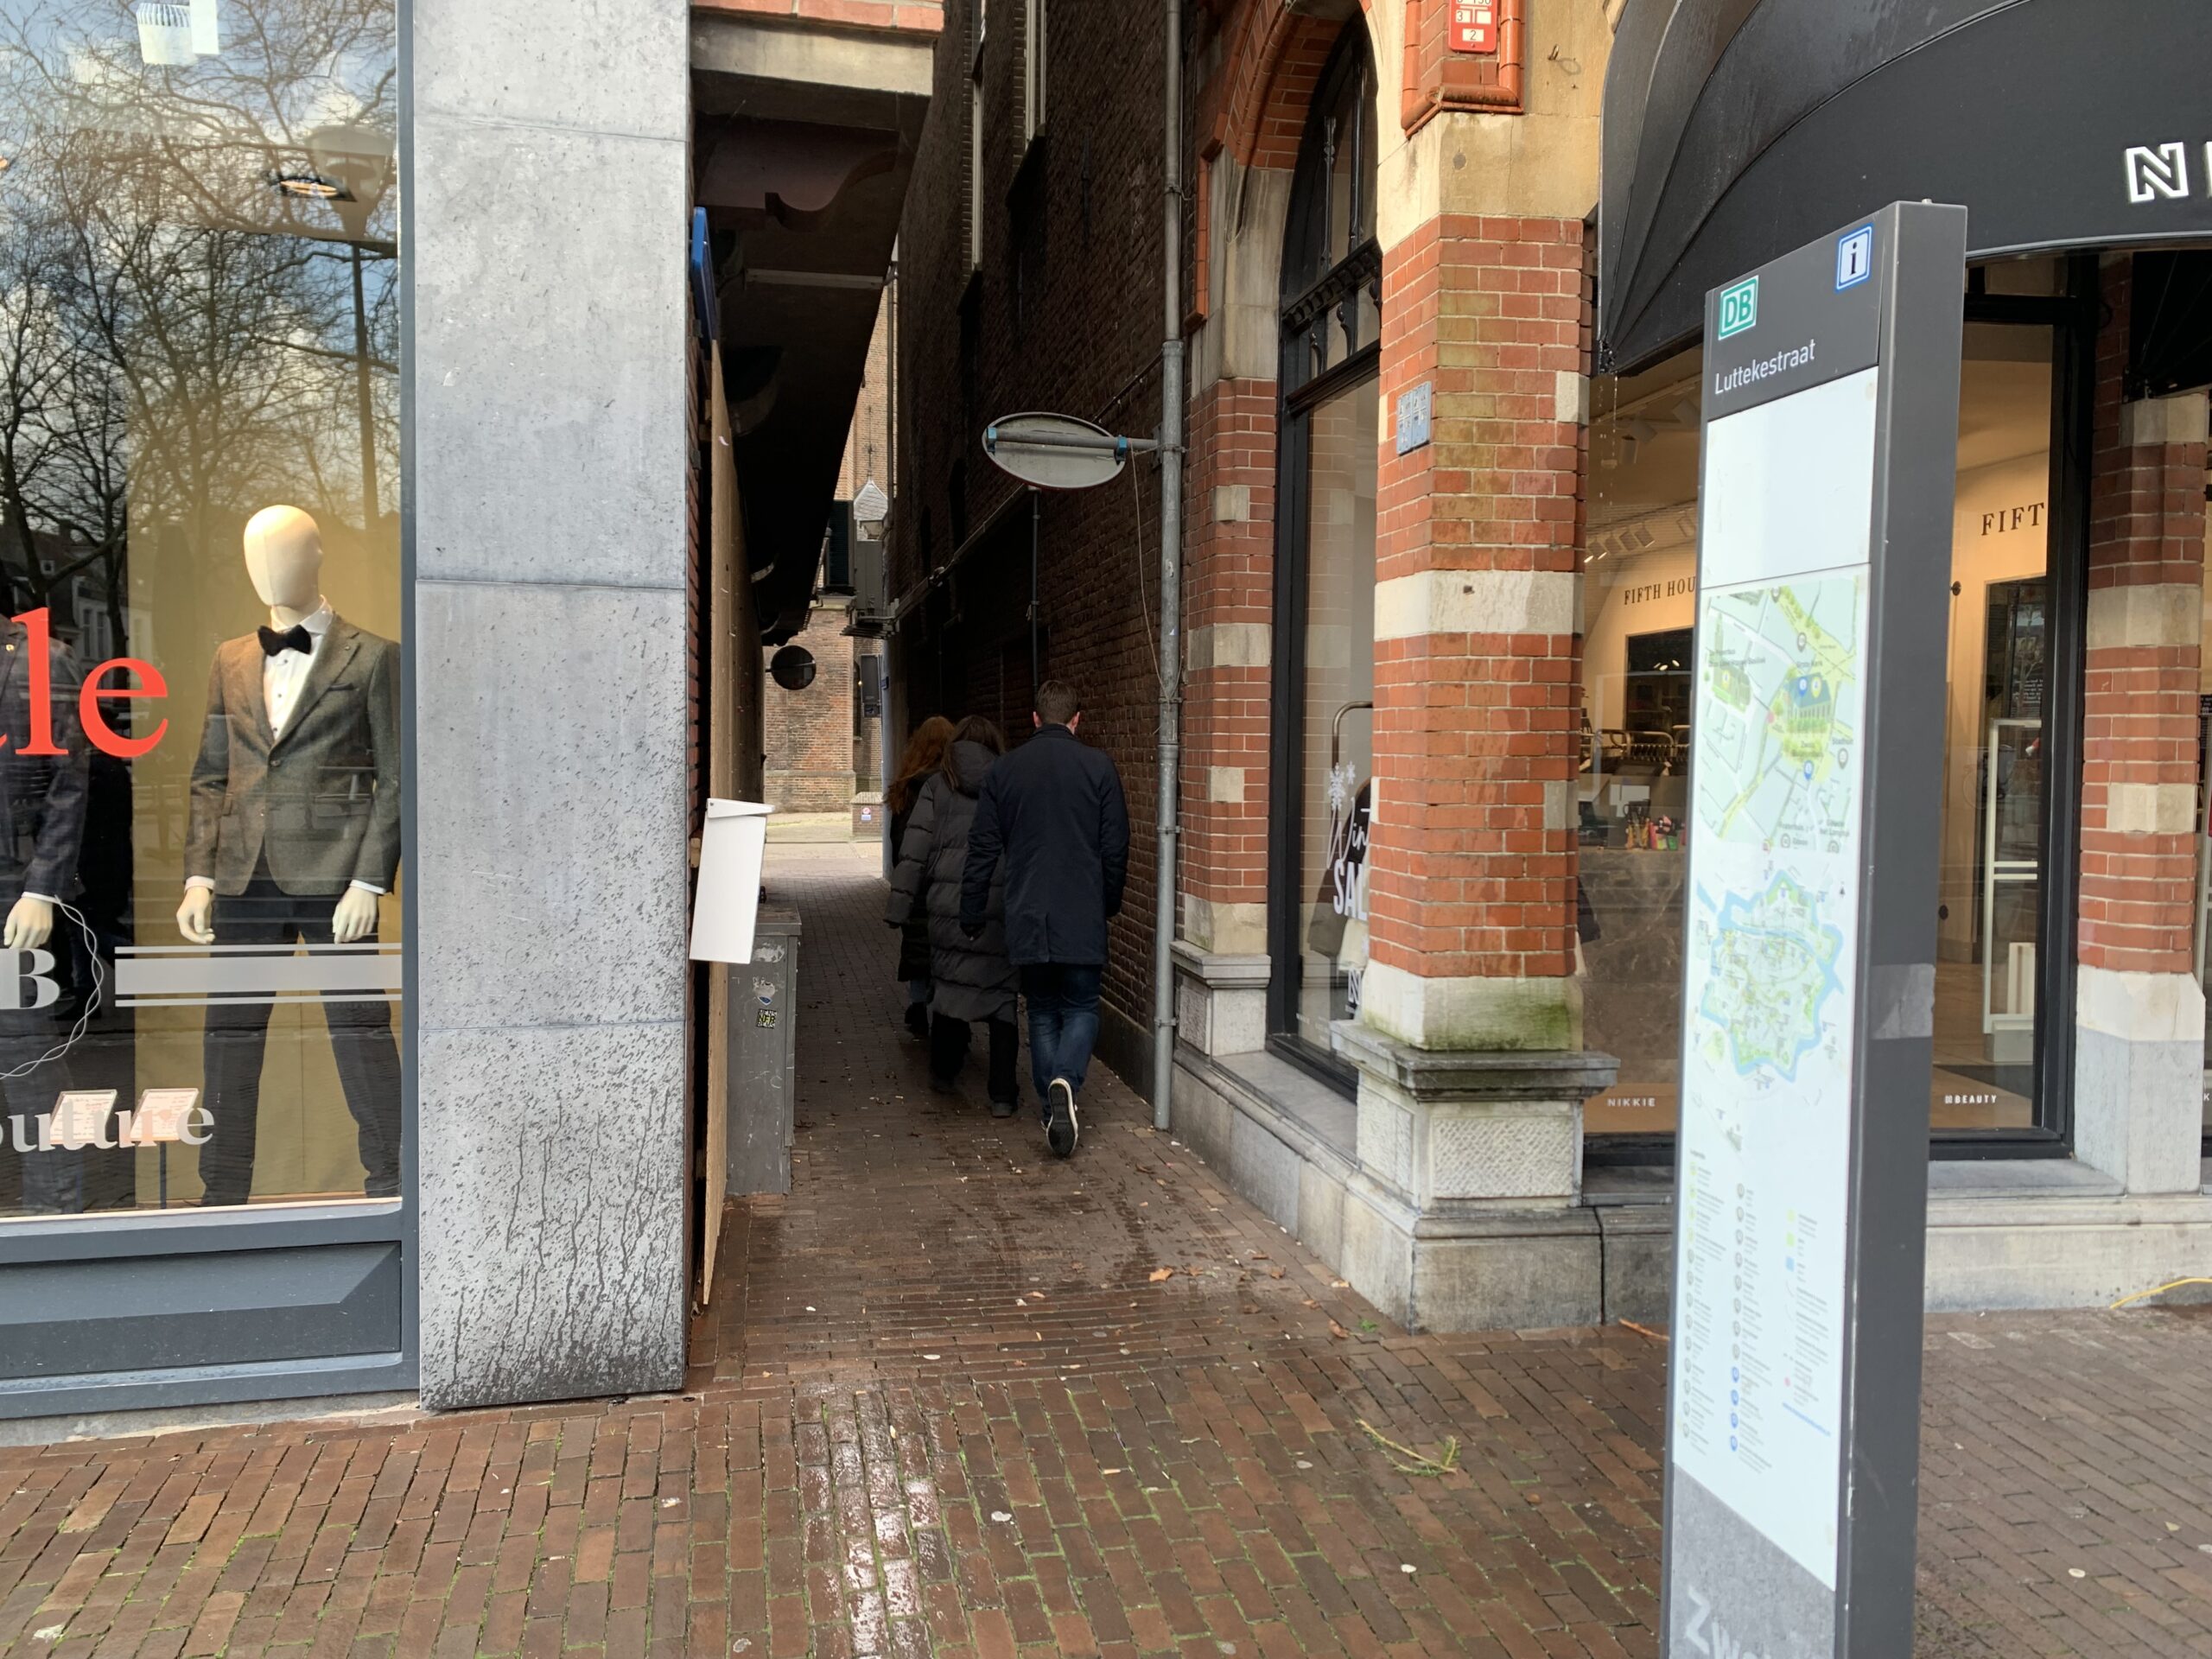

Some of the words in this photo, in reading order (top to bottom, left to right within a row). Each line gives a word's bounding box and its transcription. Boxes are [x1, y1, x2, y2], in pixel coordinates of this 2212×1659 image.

[1457, 10, 1464, 22] 3
[1470, 29, 1477, 41] 2
[1725, 289, 1752, 328] DB
[1714, 339, 1816, 395] Luttekestraat
[1980, 502, 2045, 537] FIFT
[1624, 583, 1662, 606] FIFTH
[0, 607, 169, 759] le
[1608, 1097, 1656, 1107] NIKKIE
[1955, 1095, 1998, 1104] BEAUTY
[0, 1099, 215, 1154] uture
